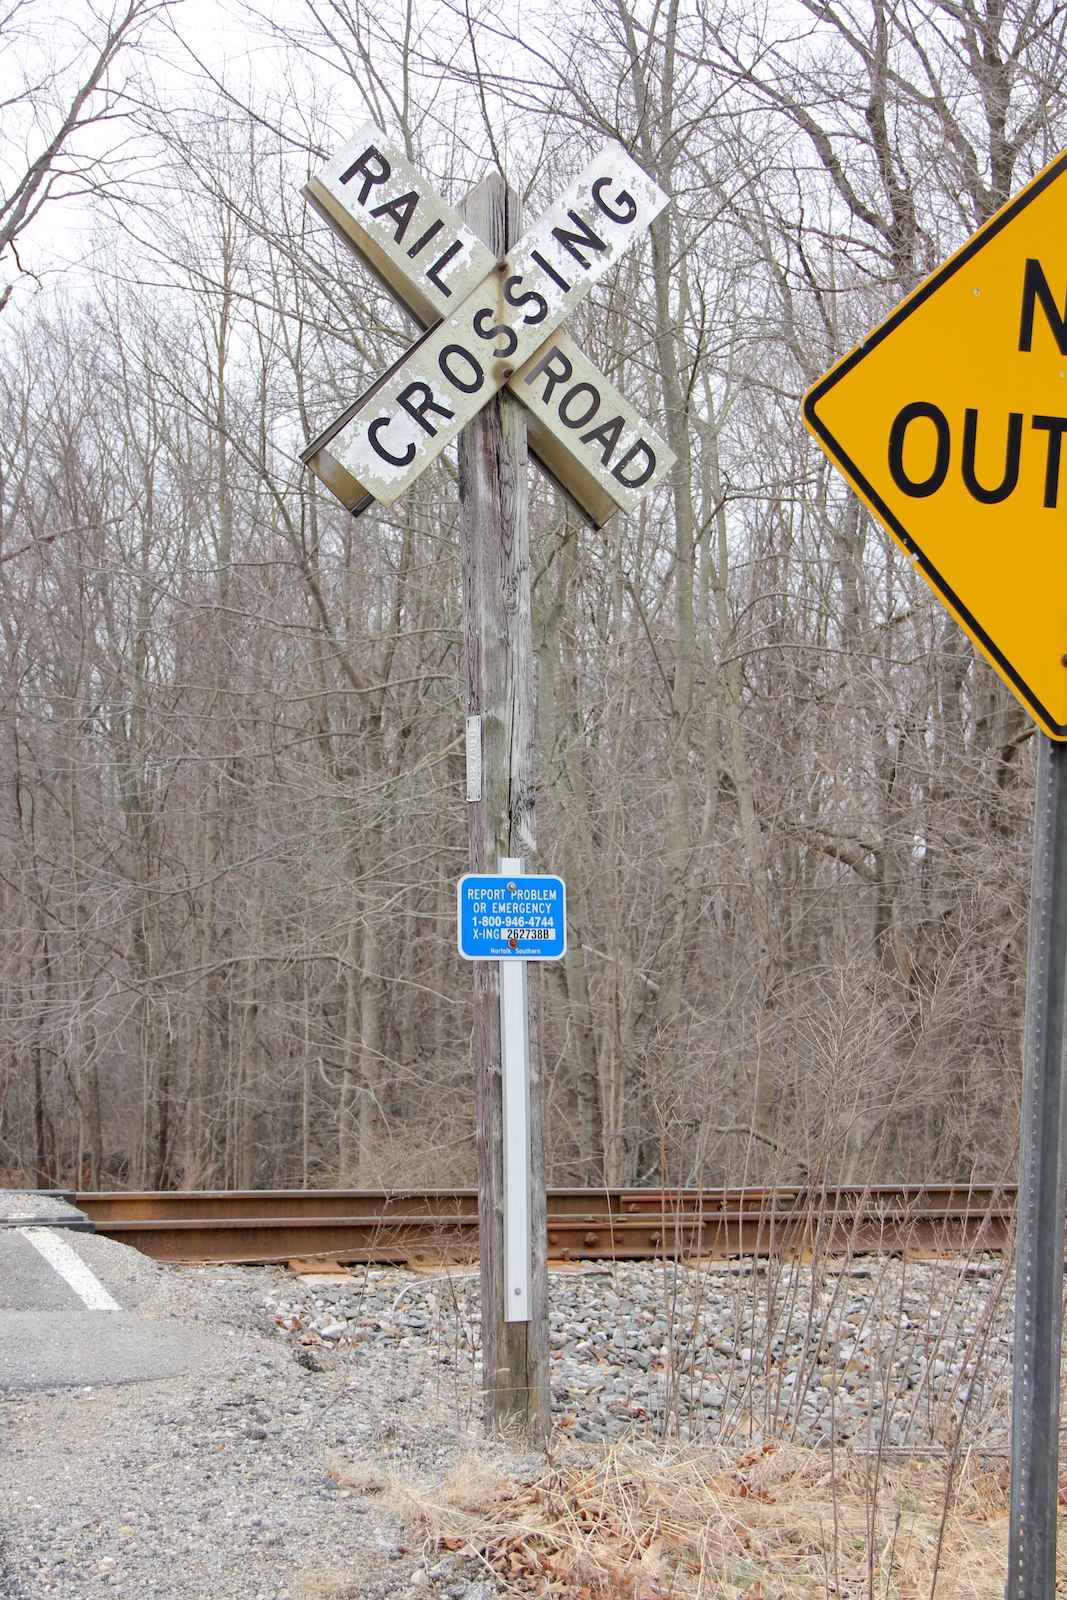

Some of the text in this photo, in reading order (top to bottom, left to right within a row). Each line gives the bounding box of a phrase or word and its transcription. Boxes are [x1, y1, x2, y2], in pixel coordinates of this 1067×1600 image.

[339, 144, 657, 489] RAIL ROAD
[367, 176, 638, 467] CROSSING
[467, 888, 557, 901] REPORT PROBLEM
[472, 902, 552, 914] OR EMERGENCY
[472, 916, 554, 927] 1-800-946-4744
[472, 928, 549, 939] X-ING 262738B
